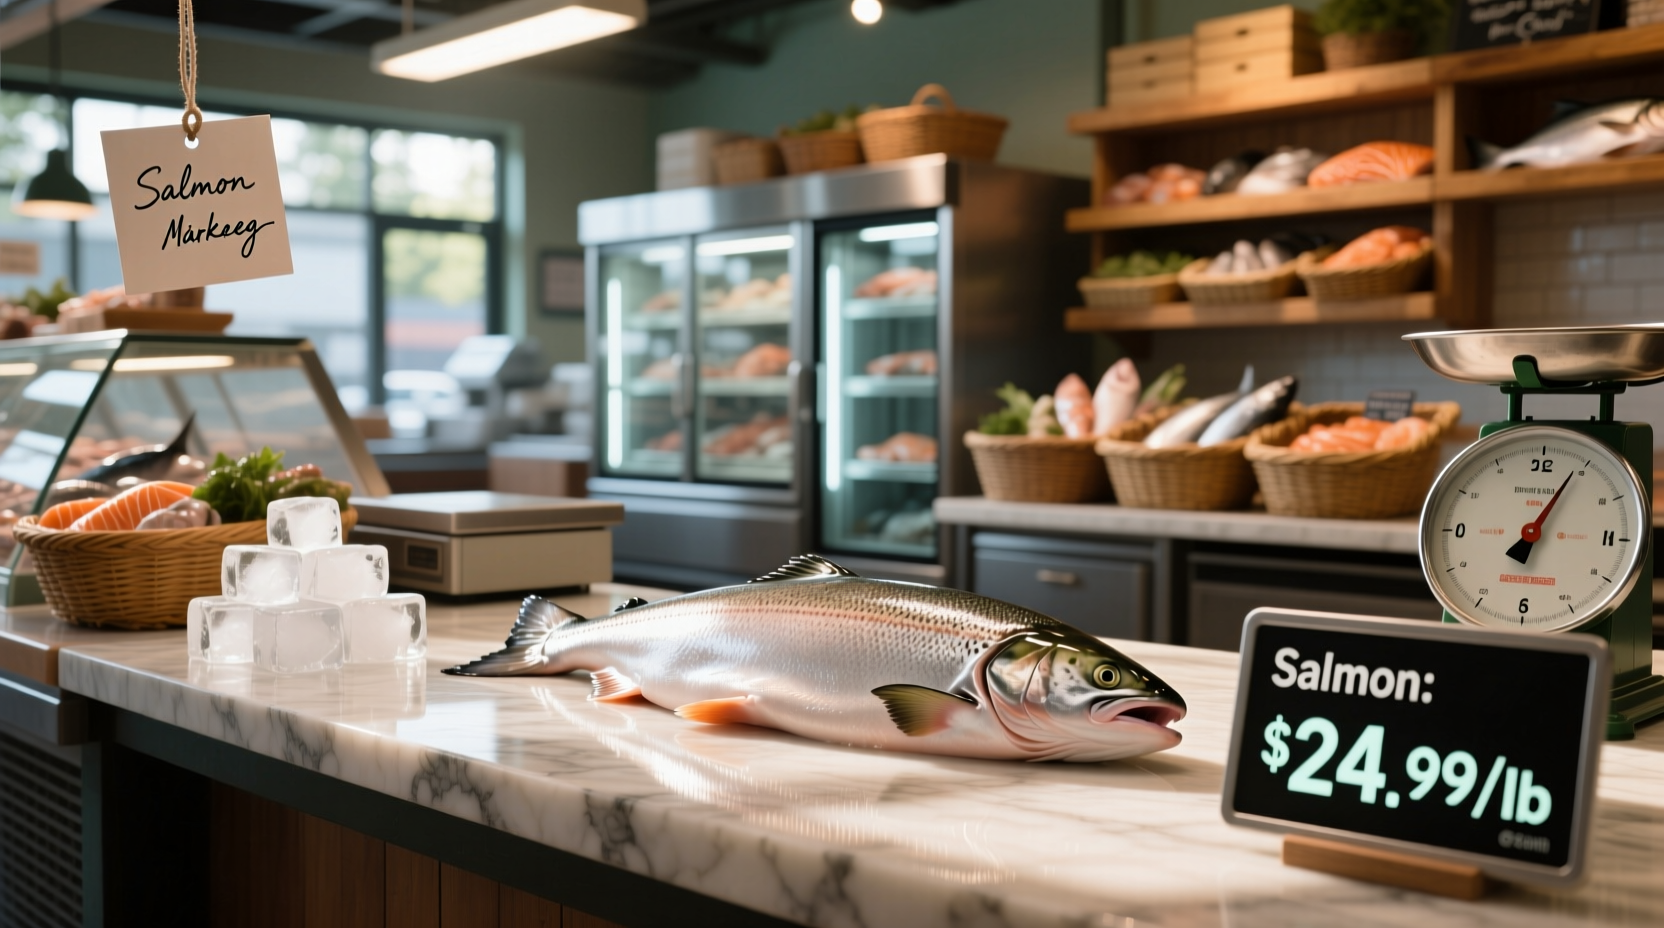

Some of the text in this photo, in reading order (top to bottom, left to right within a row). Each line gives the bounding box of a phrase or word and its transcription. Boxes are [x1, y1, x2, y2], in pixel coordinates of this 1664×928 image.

[134, 164, 256, 210] Salmon
[1518, 598, 1529, 614] 6
[1271, 646, 1435, 704] Salmon:
[1260, 713, 1553, 826] $24.99/lb
